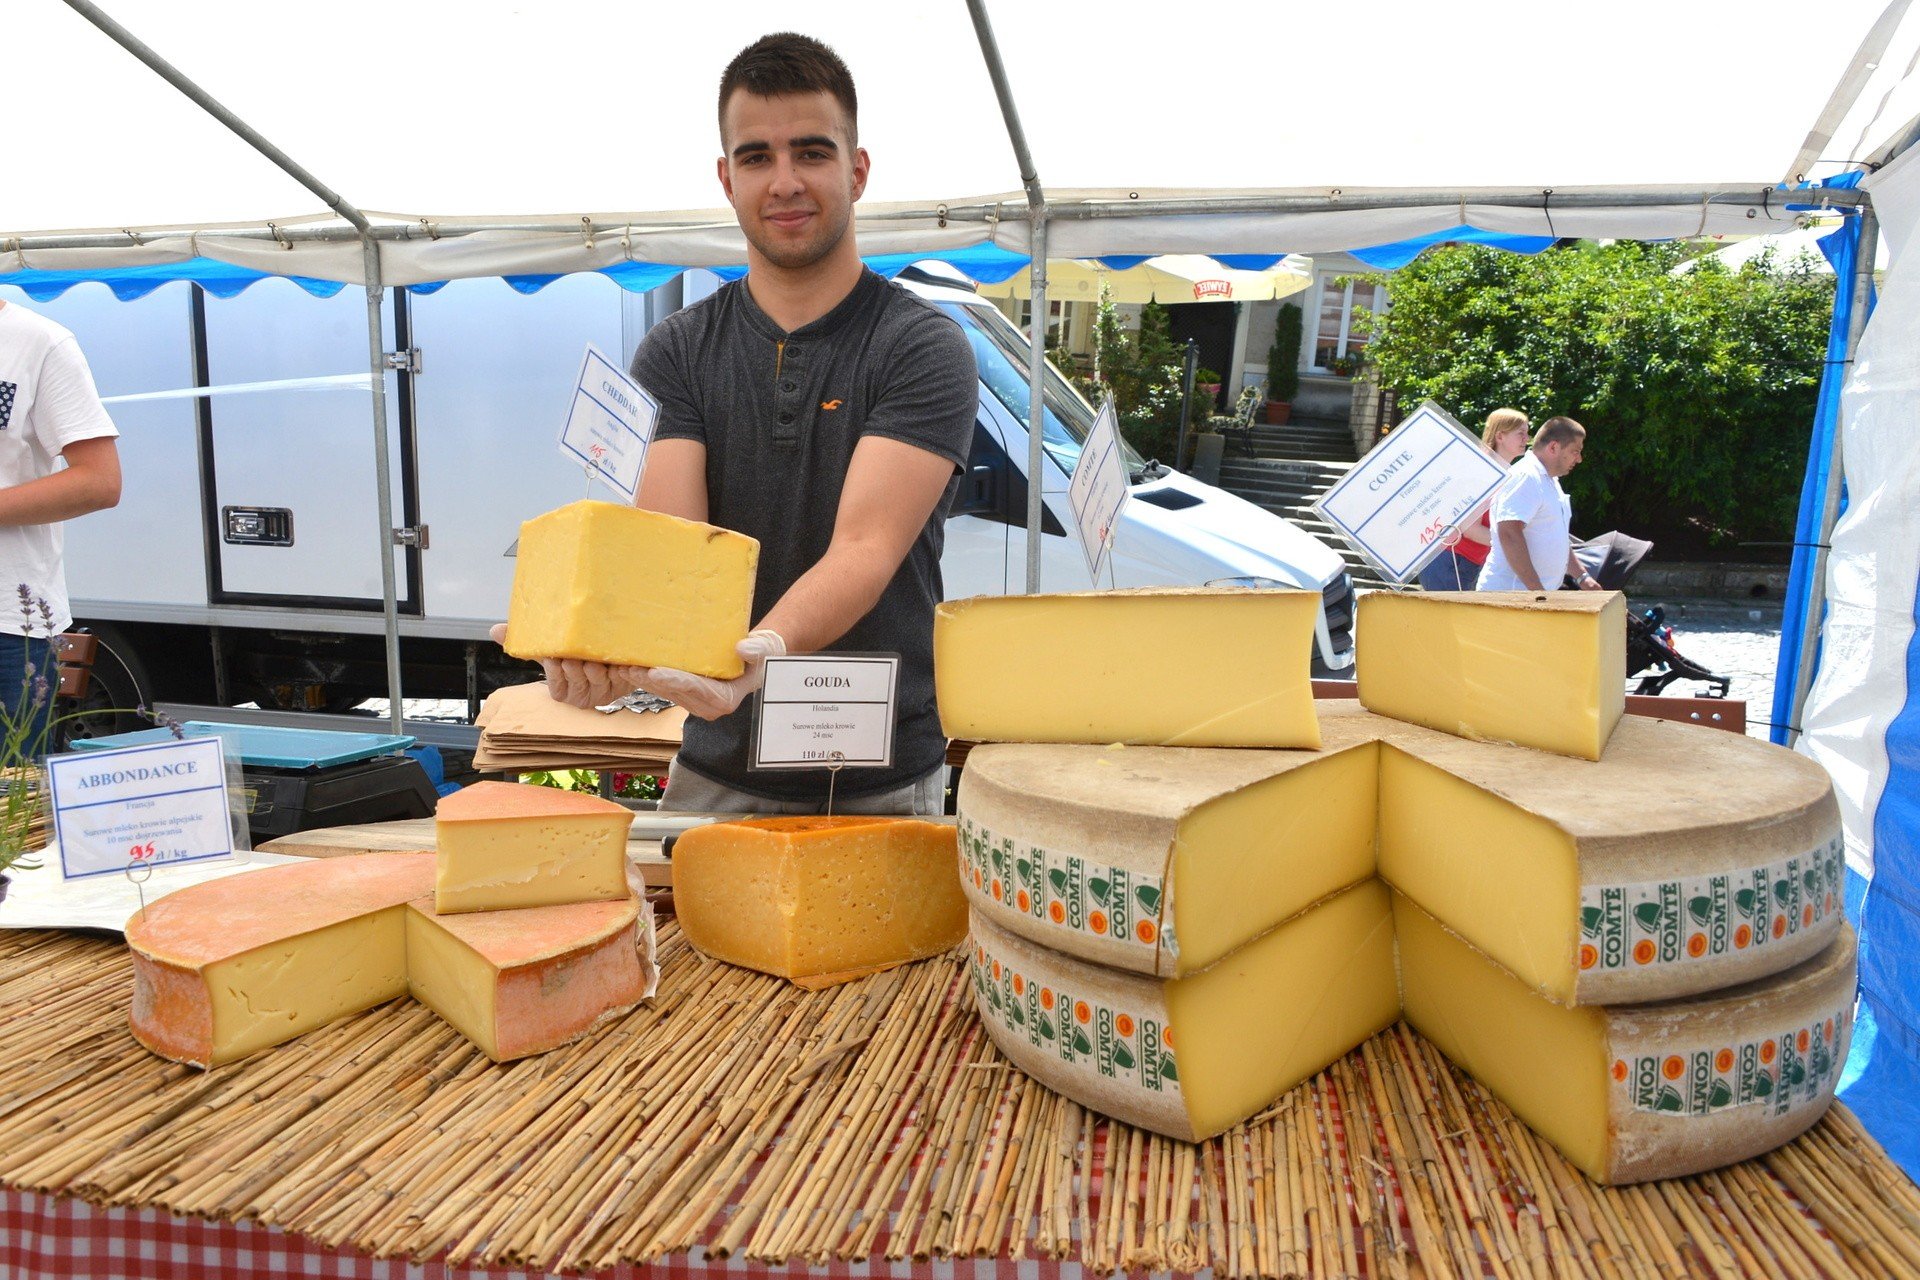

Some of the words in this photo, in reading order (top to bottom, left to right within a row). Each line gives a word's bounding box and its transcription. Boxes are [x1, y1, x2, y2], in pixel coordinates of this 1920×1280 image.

[602, 381, 637, 417] CHEDDAR
[1368, 450, 1413, 492] COMTE
[1419, 516, 1444, 546] 135
[804, 676, 851, 688] GOUDA
[812, 704, 839, 712] Holandia
[815, 722, 834, 730] mleko
[835, 722, 855, 730] krowie
[802, 750, 816, 759] 110
[77, 760, 198, 790] ABBONDANCE
[126, 800, 155, 811] Francja
[84, 827, 112, 838] Surowe
[114, 823, 139, 834] mleko
[140, 818, 167, 831] krowie
[169, 813, 203, 828] alpejskie
[129, 840, 155, 861] 95
[174, 848, 188, 859] kg
[1068, 856, 1082, 930] COMTÉ
[1605, 887, 1622, 969] COMTÉ
[1663, 882, 1678, 963] COMTÉ
[1712, 875, 1727, 955] COMTÉ
[1144, 1020, 1160, 1090] COMTÉ
